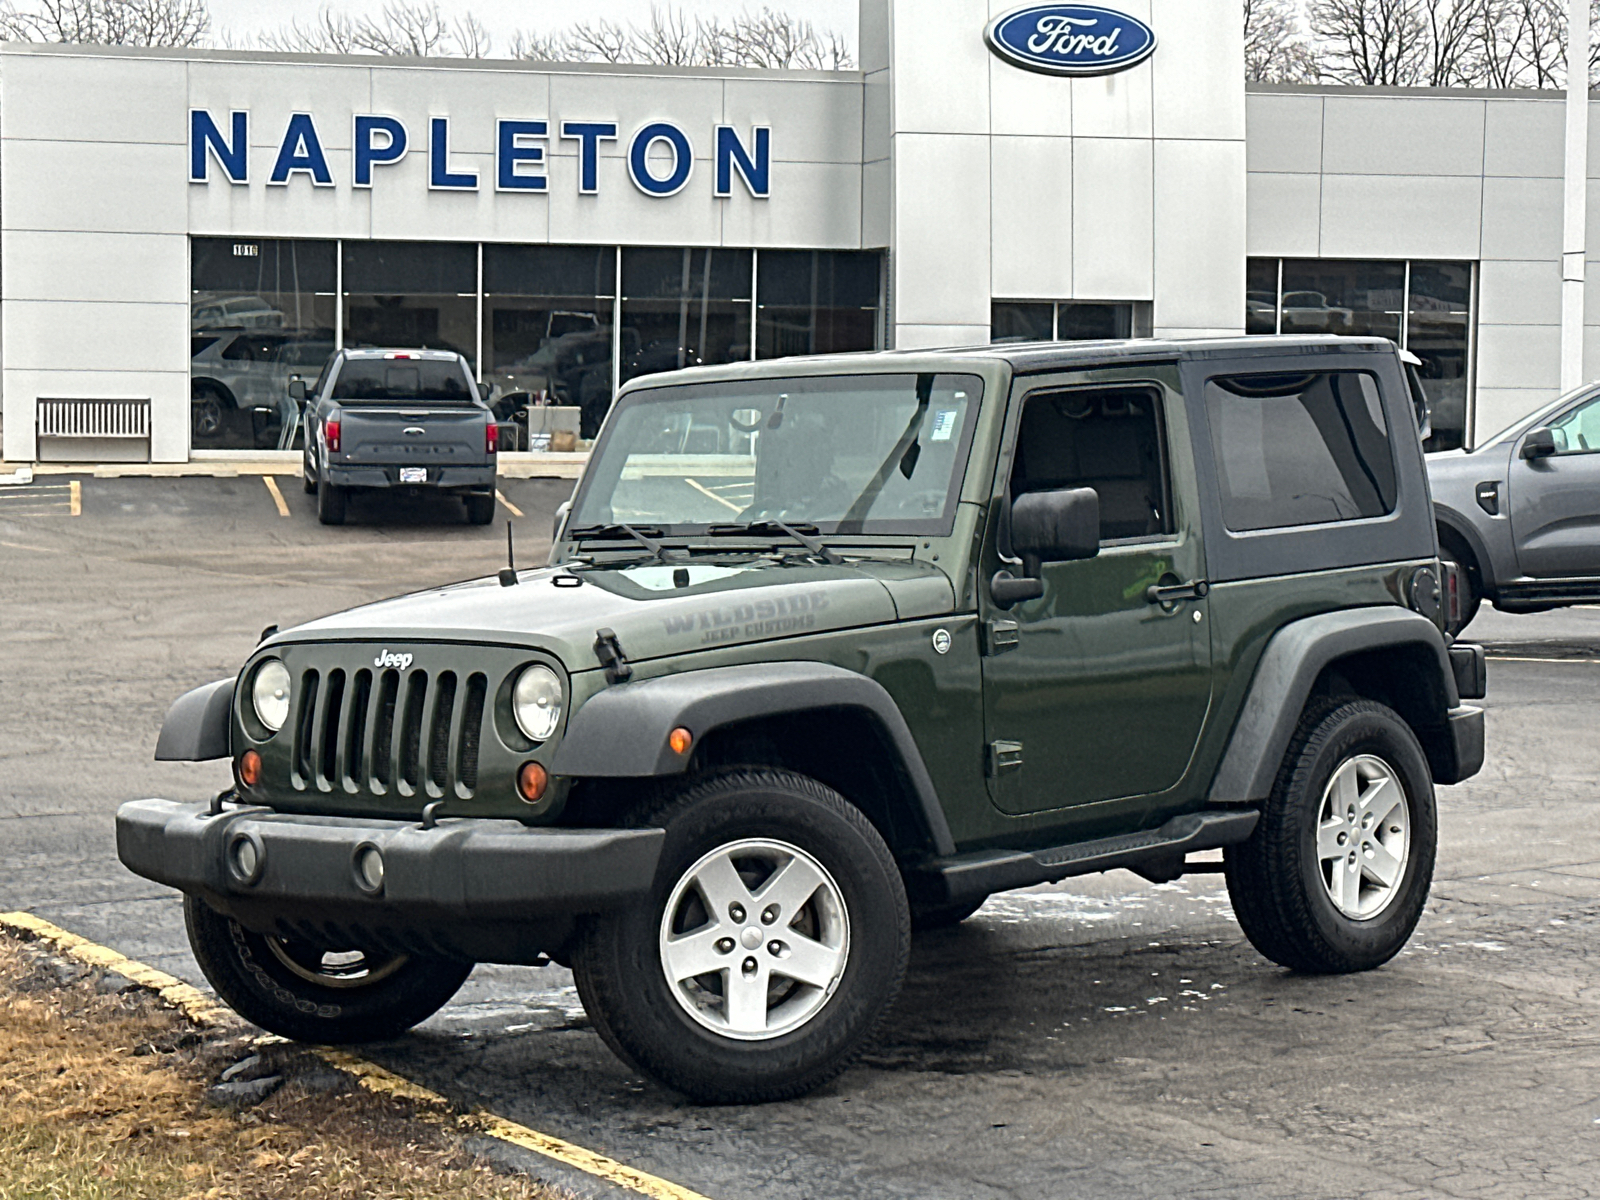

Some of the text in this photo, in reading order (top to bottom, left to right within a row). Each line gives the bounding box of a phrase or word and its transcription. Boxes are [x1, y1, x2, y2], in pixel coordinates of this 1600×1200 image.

[1027, 15, 1122, 56] Ford
[189, 108, 772, 199] NAPLETON
[661, 589, 830, 636] WILDSIDE
[701, 613, 816, 644] JEEP CUSTOMS
[374, 649, 413, 671] Jeep
